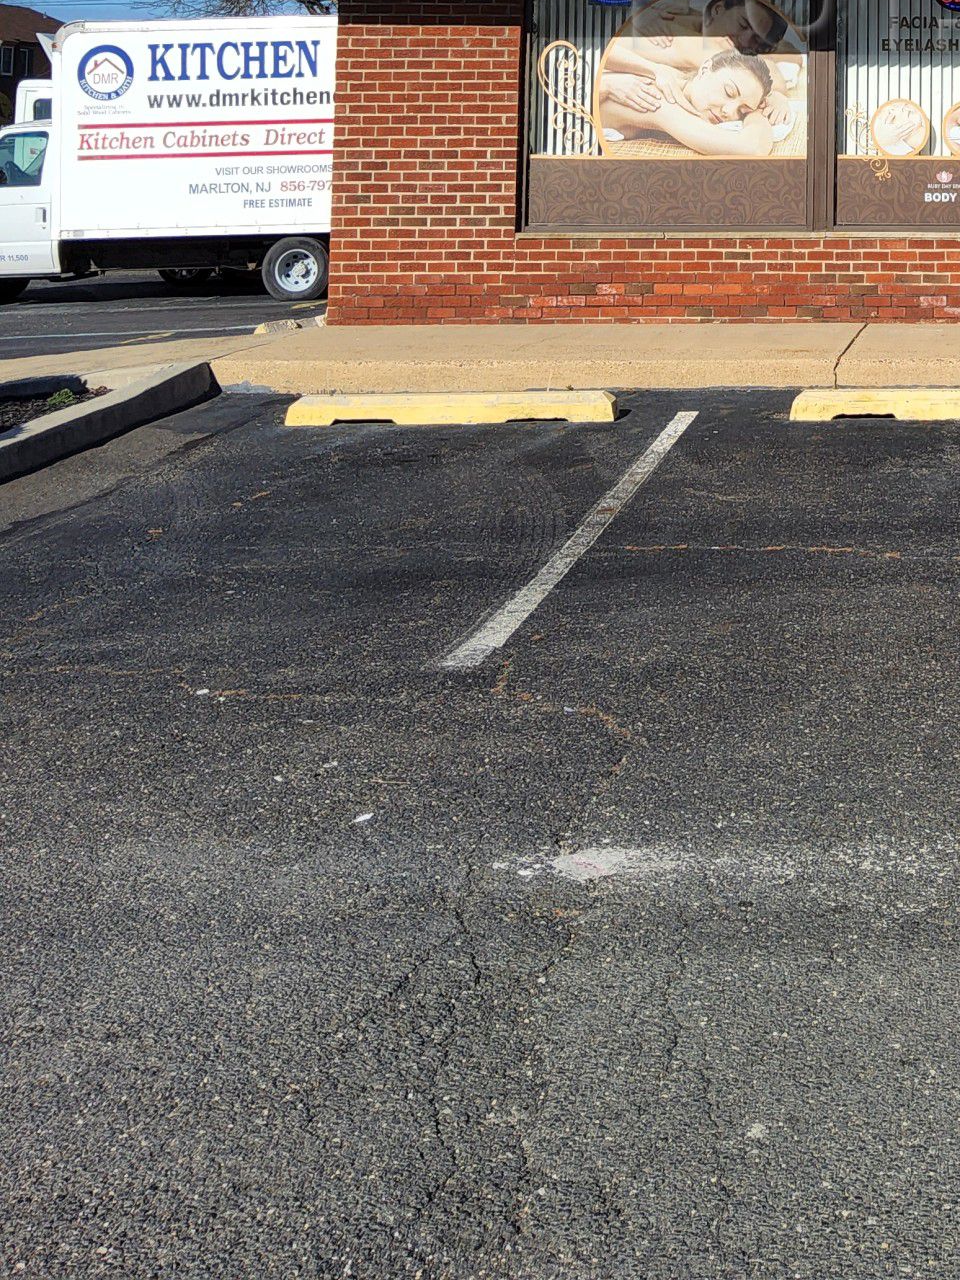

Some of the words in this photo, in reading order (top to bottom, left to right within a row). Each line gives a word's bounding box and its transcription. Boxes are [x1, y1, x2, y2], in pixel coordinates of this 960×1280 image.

[889, 16, 948, 29] FACIAL
[881, 39, 960, 52] EYELASH
[148, 40, 320, 81] KITCHEN
[93, 73, 119, 85] DMR
[80, 78, 109, 100] KITCHEN
[147, 88, 335, 108] www.dmrkitchen
[77, 131, 155, 151] Kitchen
[162, 129, 250, 149] Cabinets
[263, 127, 326, 147] Direct
[215, 167, 241, 176] VISIT
[242, 166, 264, 175] OUR
[266, 164, 334, 175] SHOWROOMS
[188, 183, 253, 195] MARLTON,
[255, 181, 271, 193] NJ
[243, 199, 266, 208] FREE
[268, 197, 313, 207] ESTIMATE
[924, 192, 957, 203] BODY
[8, 254, 29, 262] 11,500
